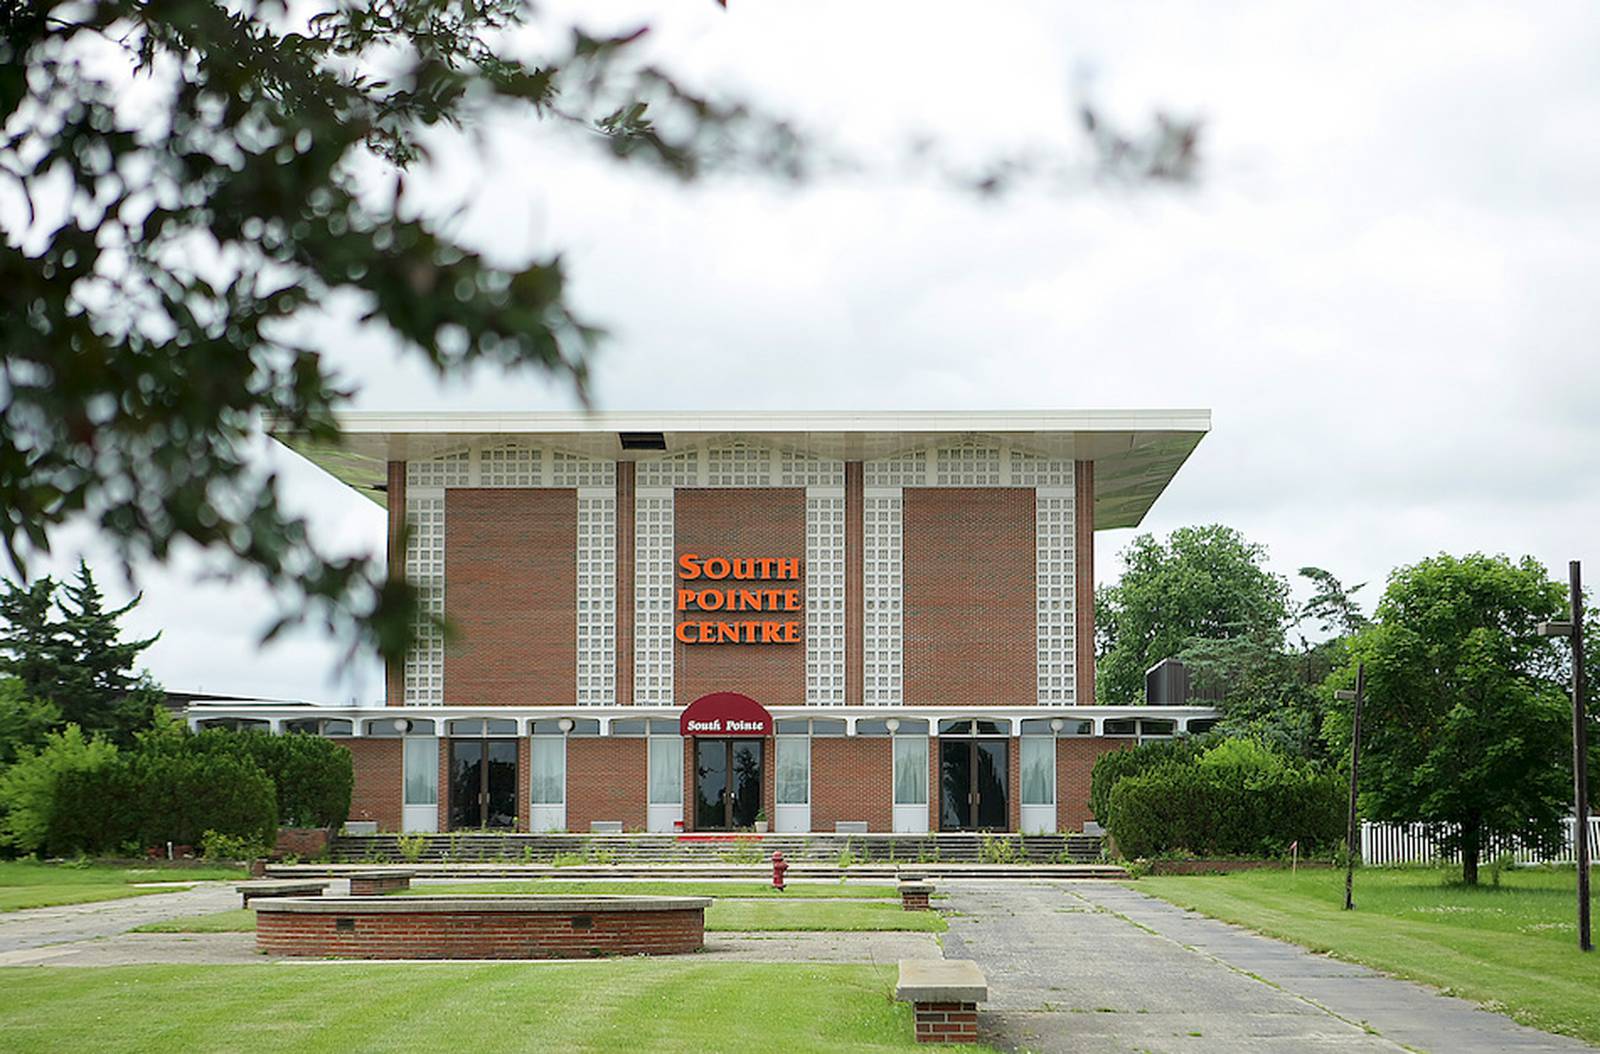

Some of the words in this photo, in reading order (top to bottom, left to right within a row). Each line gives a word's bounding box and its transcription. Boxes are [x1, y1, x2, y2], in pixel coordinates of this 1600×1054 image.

[678, 553, 800, 580] SOUTH
[677, 589, 801, 611] POINTE
[675, 621, 801, 643] CENTRE
[687, 719, 721, 731] South
[726, 720, 764, 731] Pointe
